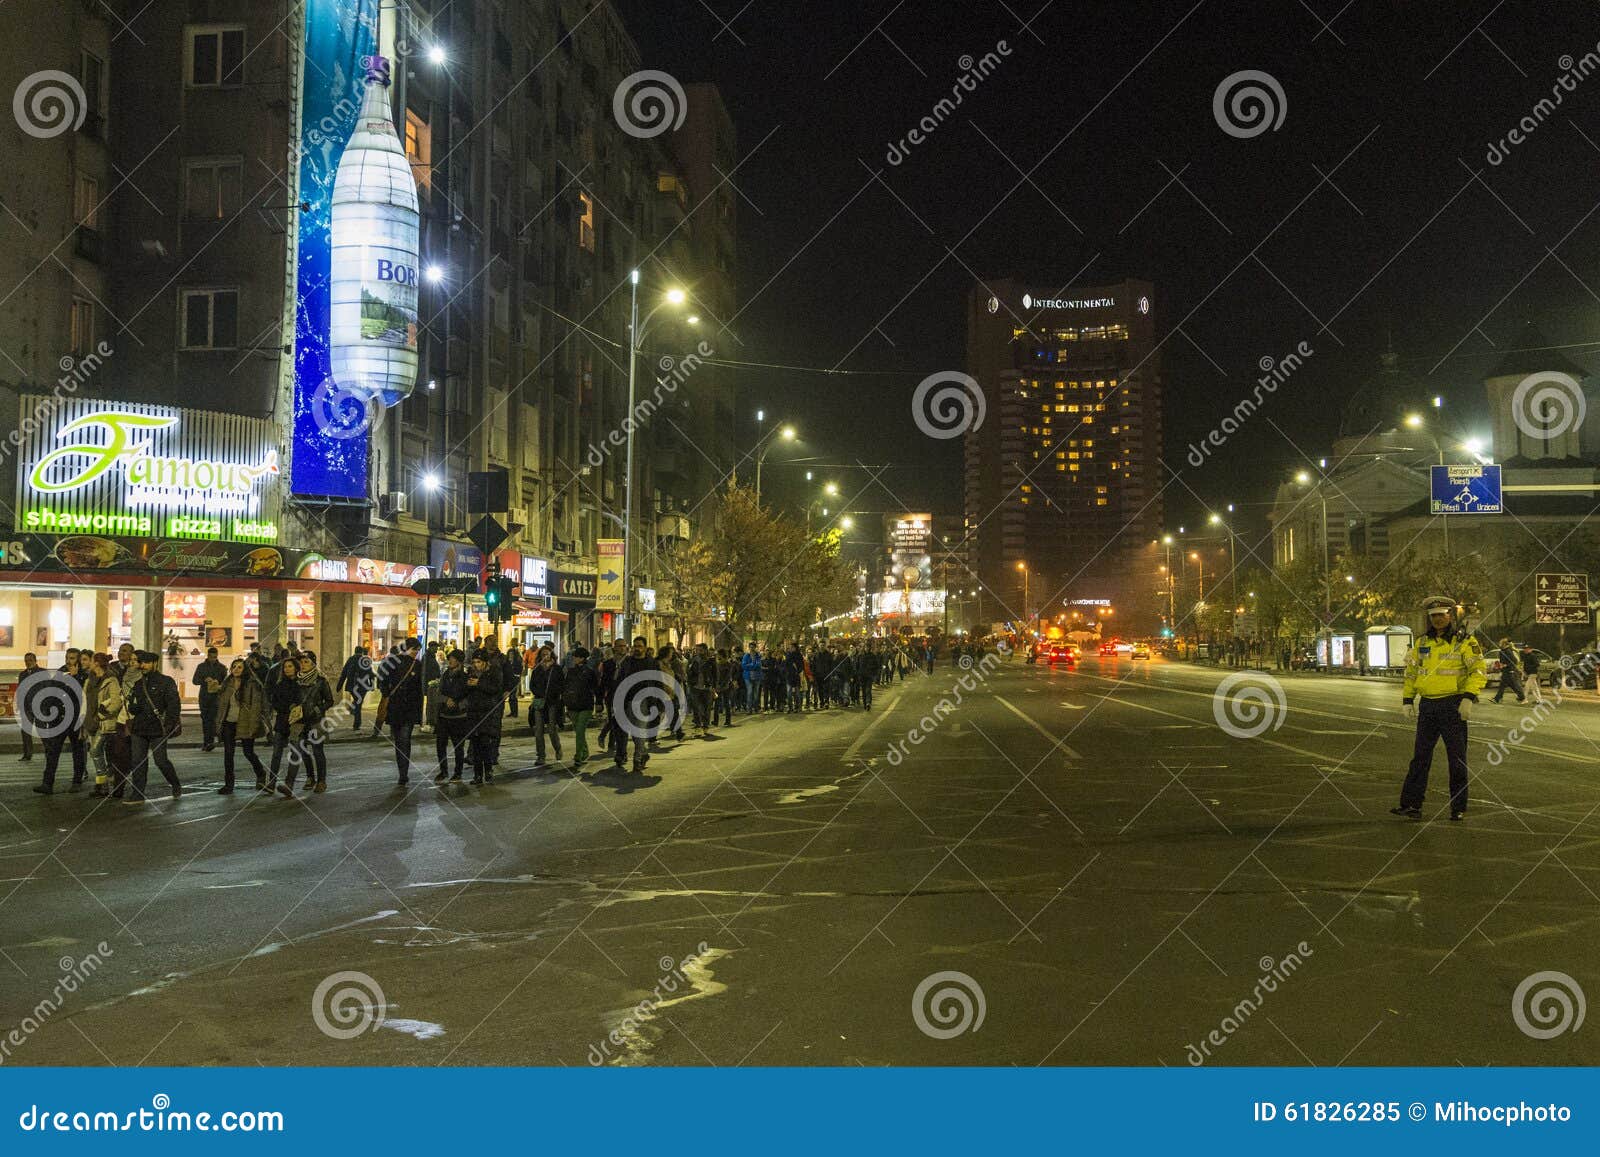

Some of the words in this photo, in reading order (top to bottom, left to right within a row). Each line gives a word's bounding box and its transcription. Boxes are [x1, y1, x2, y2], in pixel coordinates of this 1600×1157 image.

[377, 259, 418, 288] BOR
[29, 411, 279, 493] Famous
[26, 508, 151, 532] shaworma
[171, 515, 221, 536] pizza
[234, 518, 278, 538] kebab
